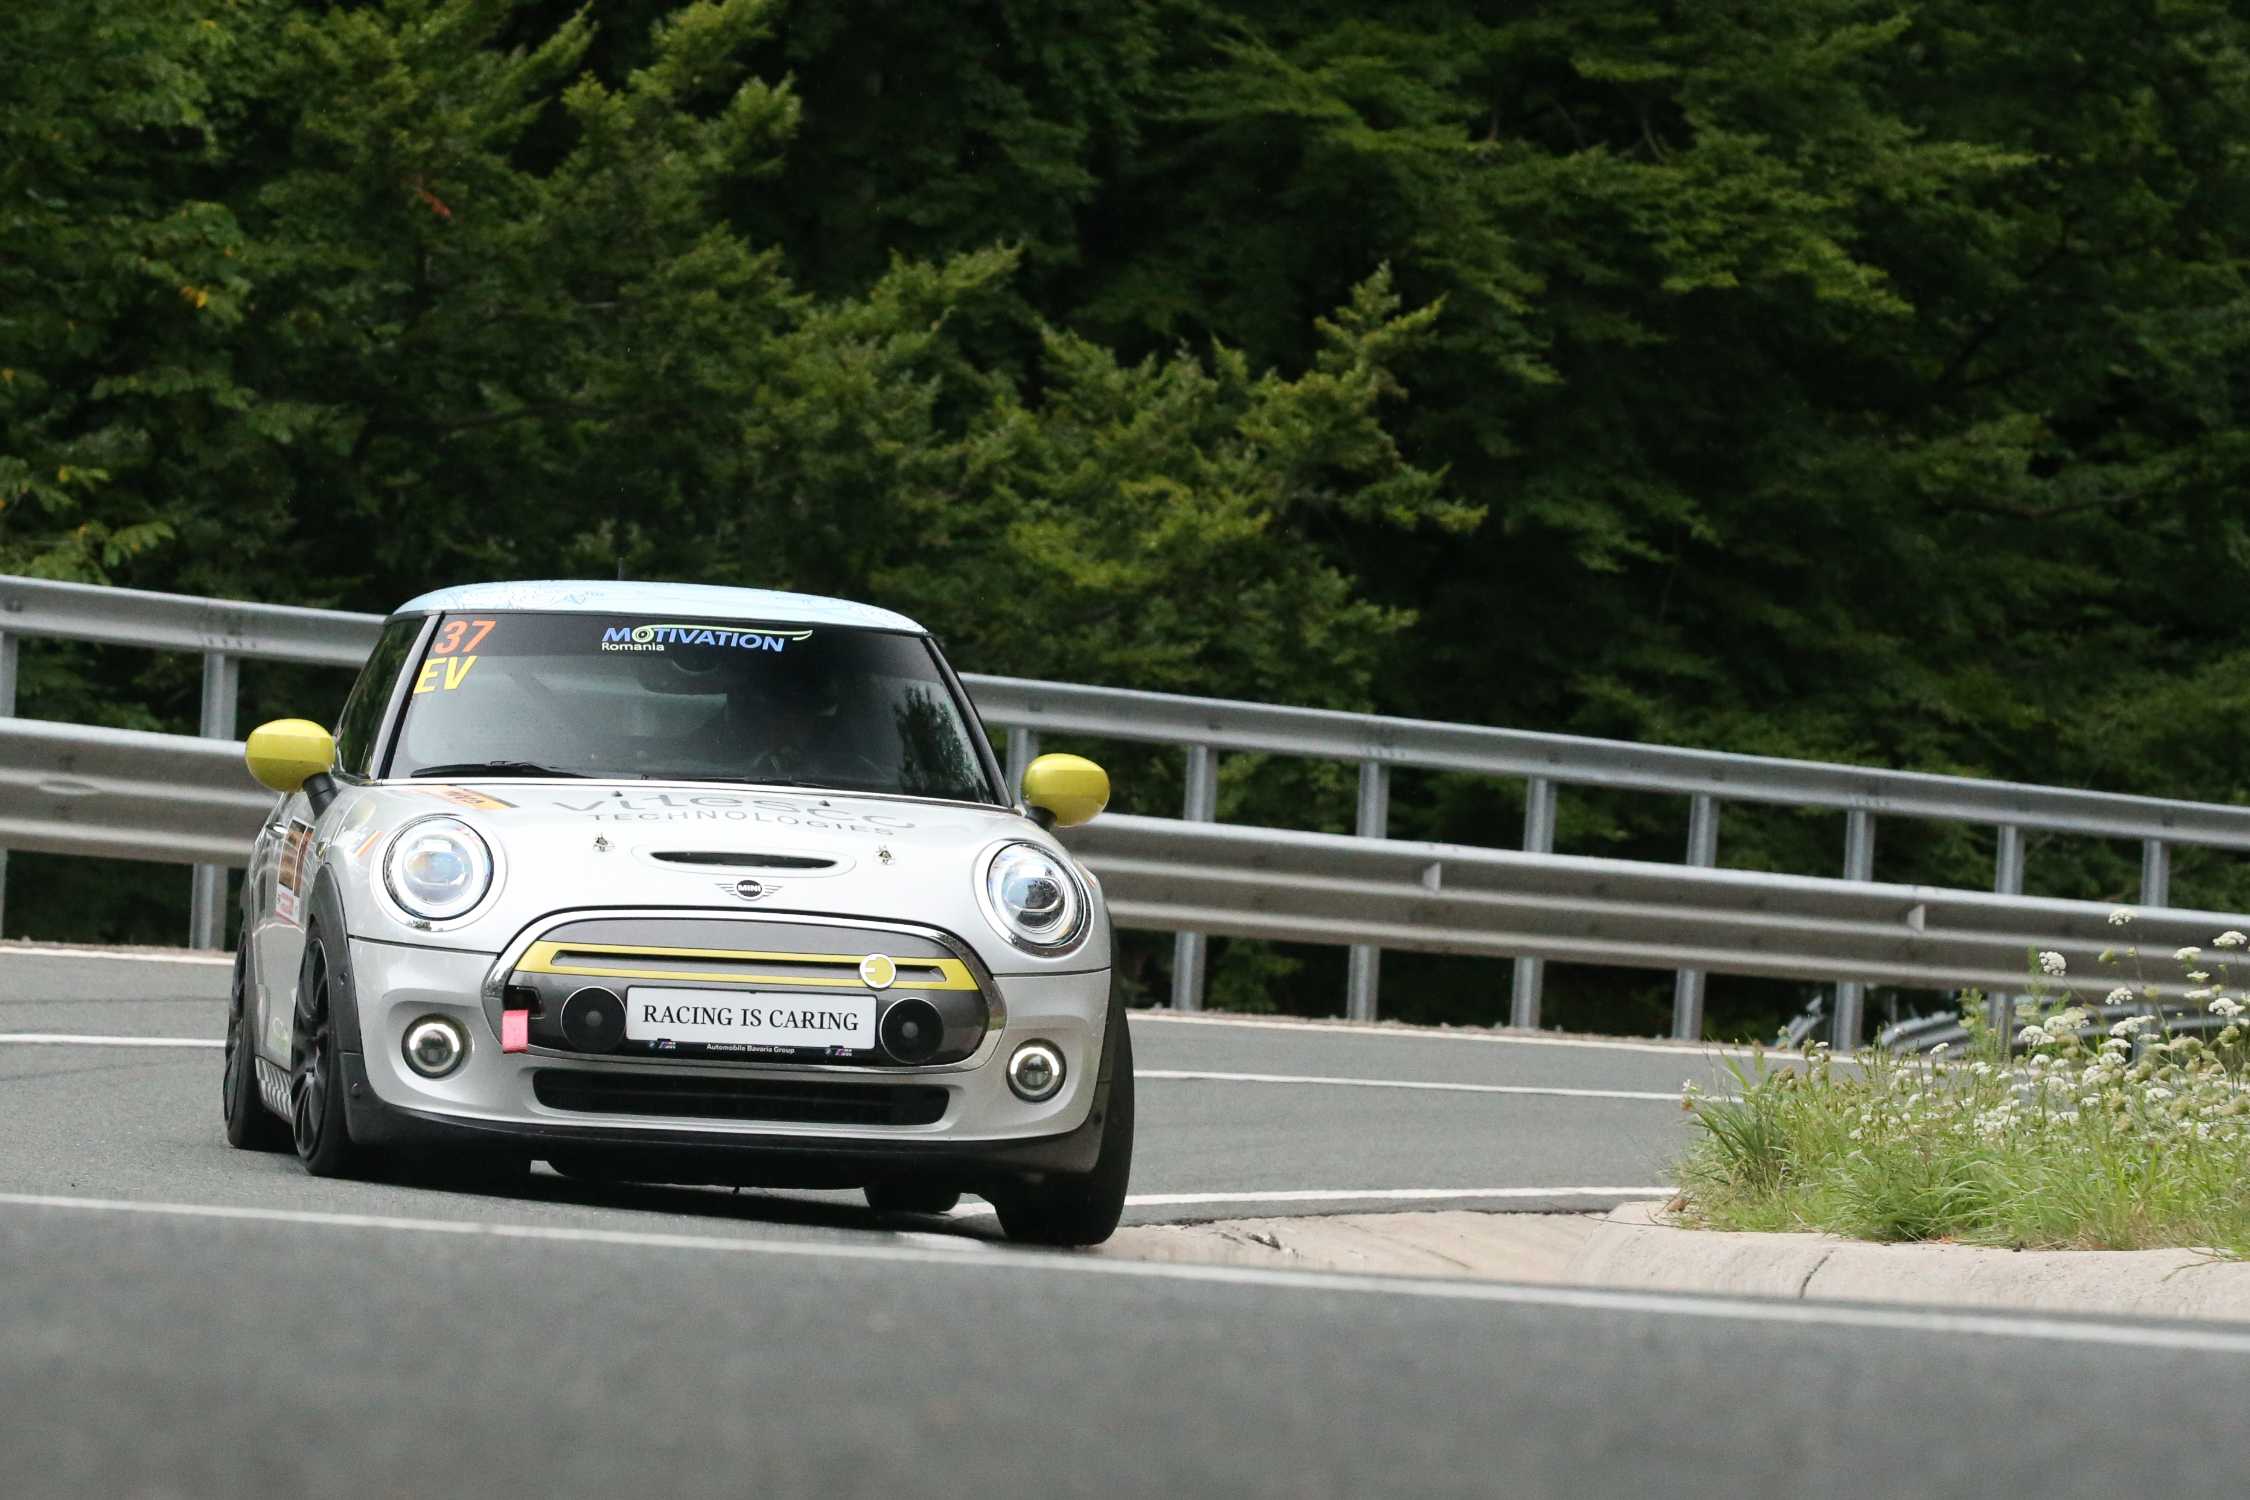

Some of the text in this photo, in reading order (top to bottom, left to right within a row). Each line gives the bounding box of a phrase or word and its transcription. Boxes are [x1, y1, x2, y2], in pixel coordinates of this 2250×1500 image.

[434, 620, 497, 654] 37
[601, 626, 786, 652] MOTIVATION
[601, 642, 665, 651] Romania
[413, 655, 478, 694] EV
[588, 809, 894, 836] TECHNOLOGIES
[738, 884, 761, 892] MINI
[643, 1004, 859, 1031] RACING IS CARING
[706, 1043, 795, 1054] Automobile Bavaria Group
